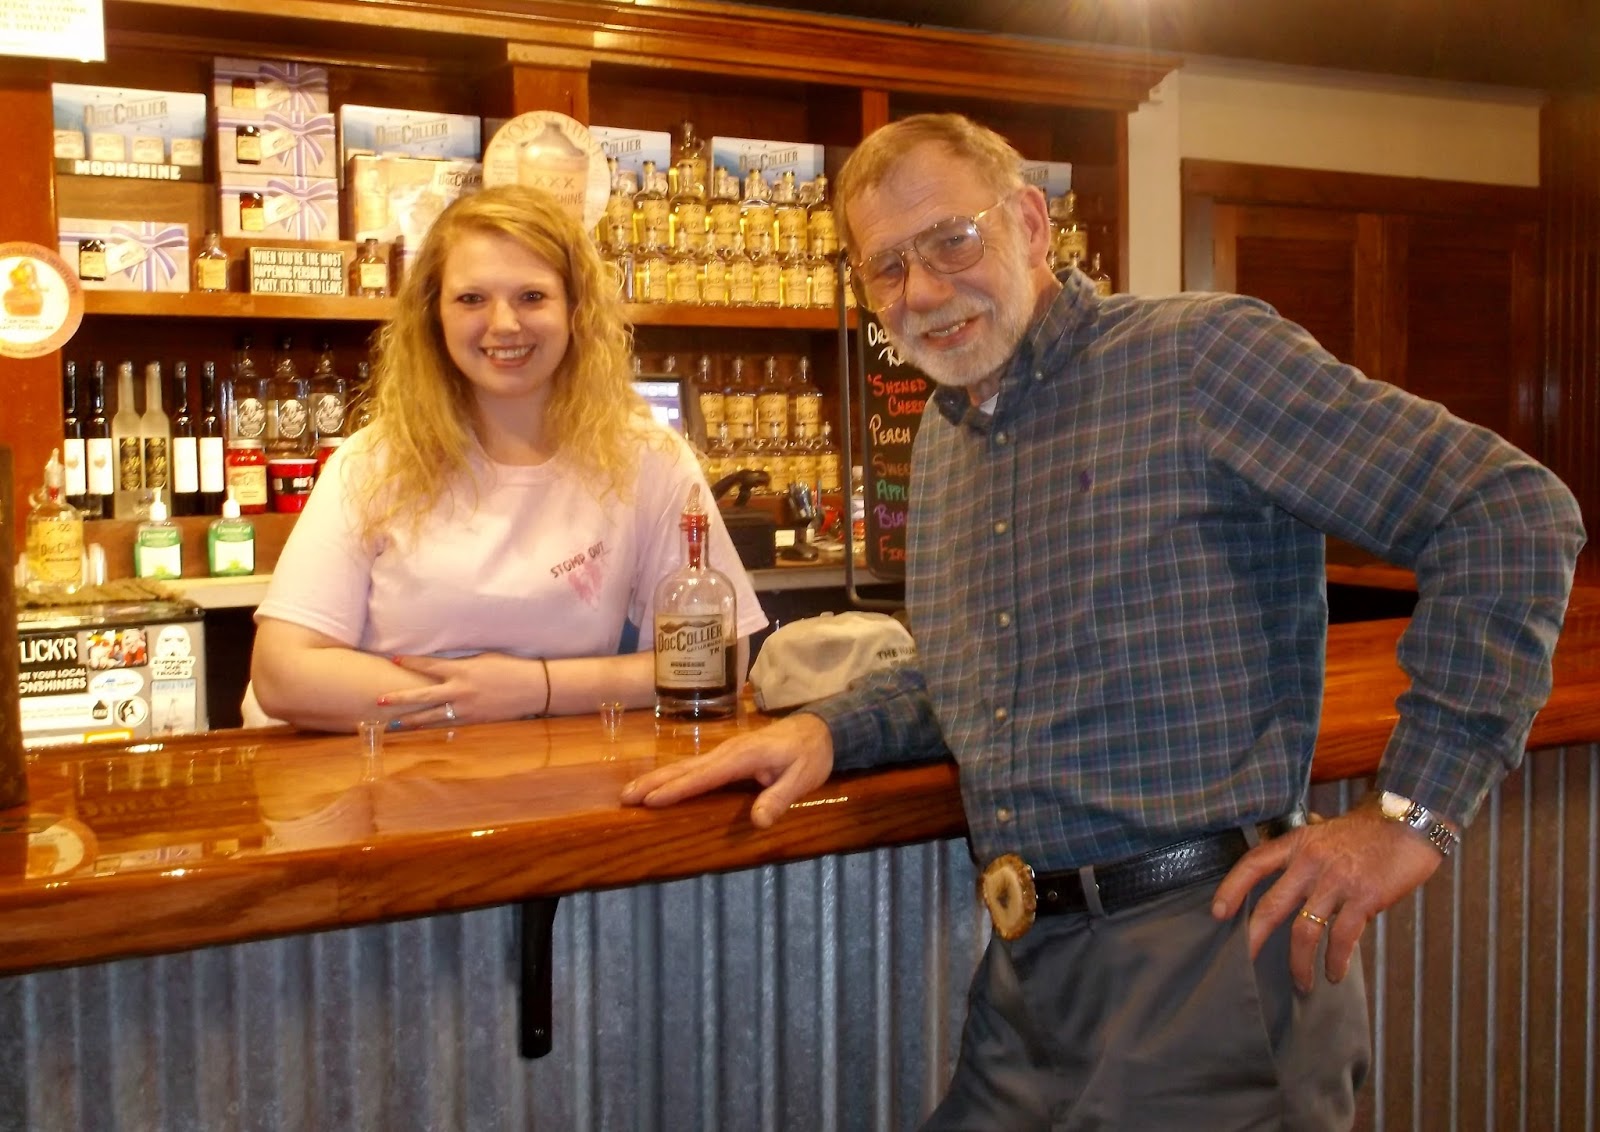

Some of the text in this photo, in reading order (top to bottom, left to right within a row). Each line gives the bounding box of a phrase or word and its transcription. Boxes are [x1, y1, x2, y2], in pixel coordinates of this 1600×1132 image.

[75, 159, 182, 180] MOONSHINE
[253, 250, 342, 268] WHEN YOU'RE THE MOST
[253, 264, 342, 281] HAPPENING PERSON AT THE
[294, 279, 311, 294] TIME
[312, 280, 322, 295] TO
[322, 280, 343, 296] LEAVE
[888, 395, 926, 417] CHERR
[869, 414, 911, 446] PEACH
[876, 479, 909, 501] APPL
[550, 553, 586, 579] STOMP
[18, 637, 78, 664] LICK'R
[876, 648, 898, 660] THE
[57, 667, 87, 679] LOCAL
[18, 677, 87, 694] ONSHINERS
